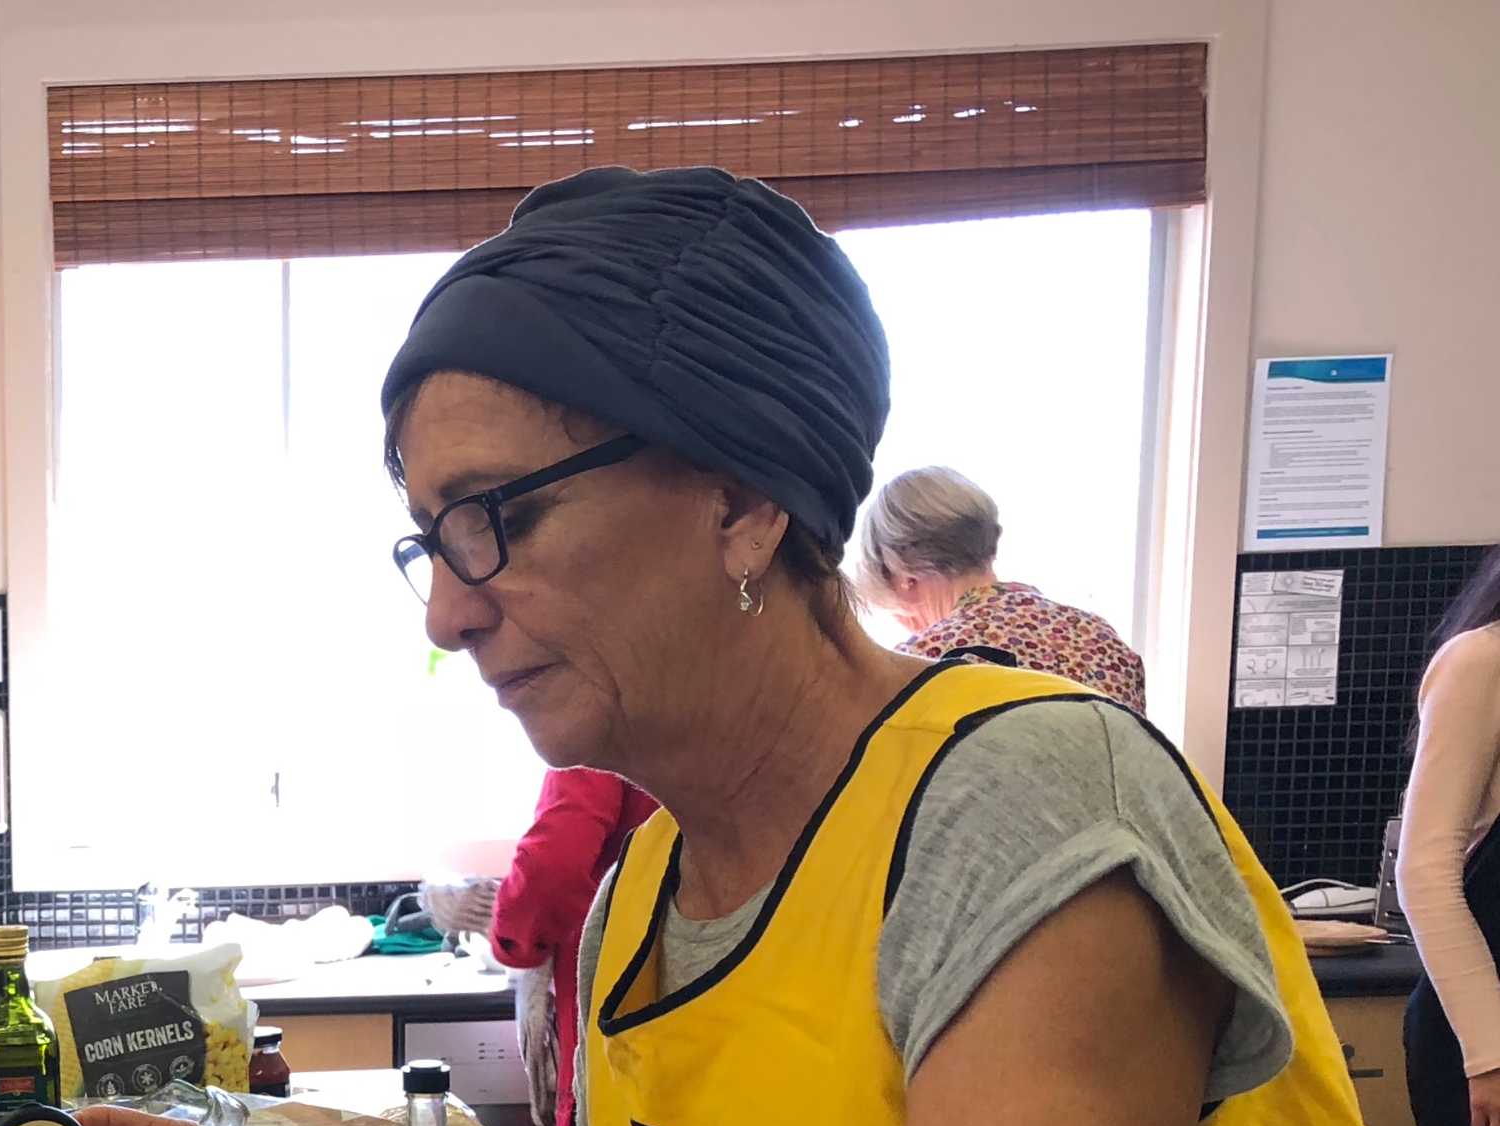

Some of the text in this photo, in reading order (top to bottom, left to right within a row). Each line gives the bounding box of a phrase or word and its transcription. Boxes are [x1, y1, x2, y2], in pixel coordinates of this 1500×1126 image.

[94, 981, 159, 1005] MARKET
[108, 995, 148, 1015] FARE
[84, 1020, 195, 1063] CORN KERNELS
